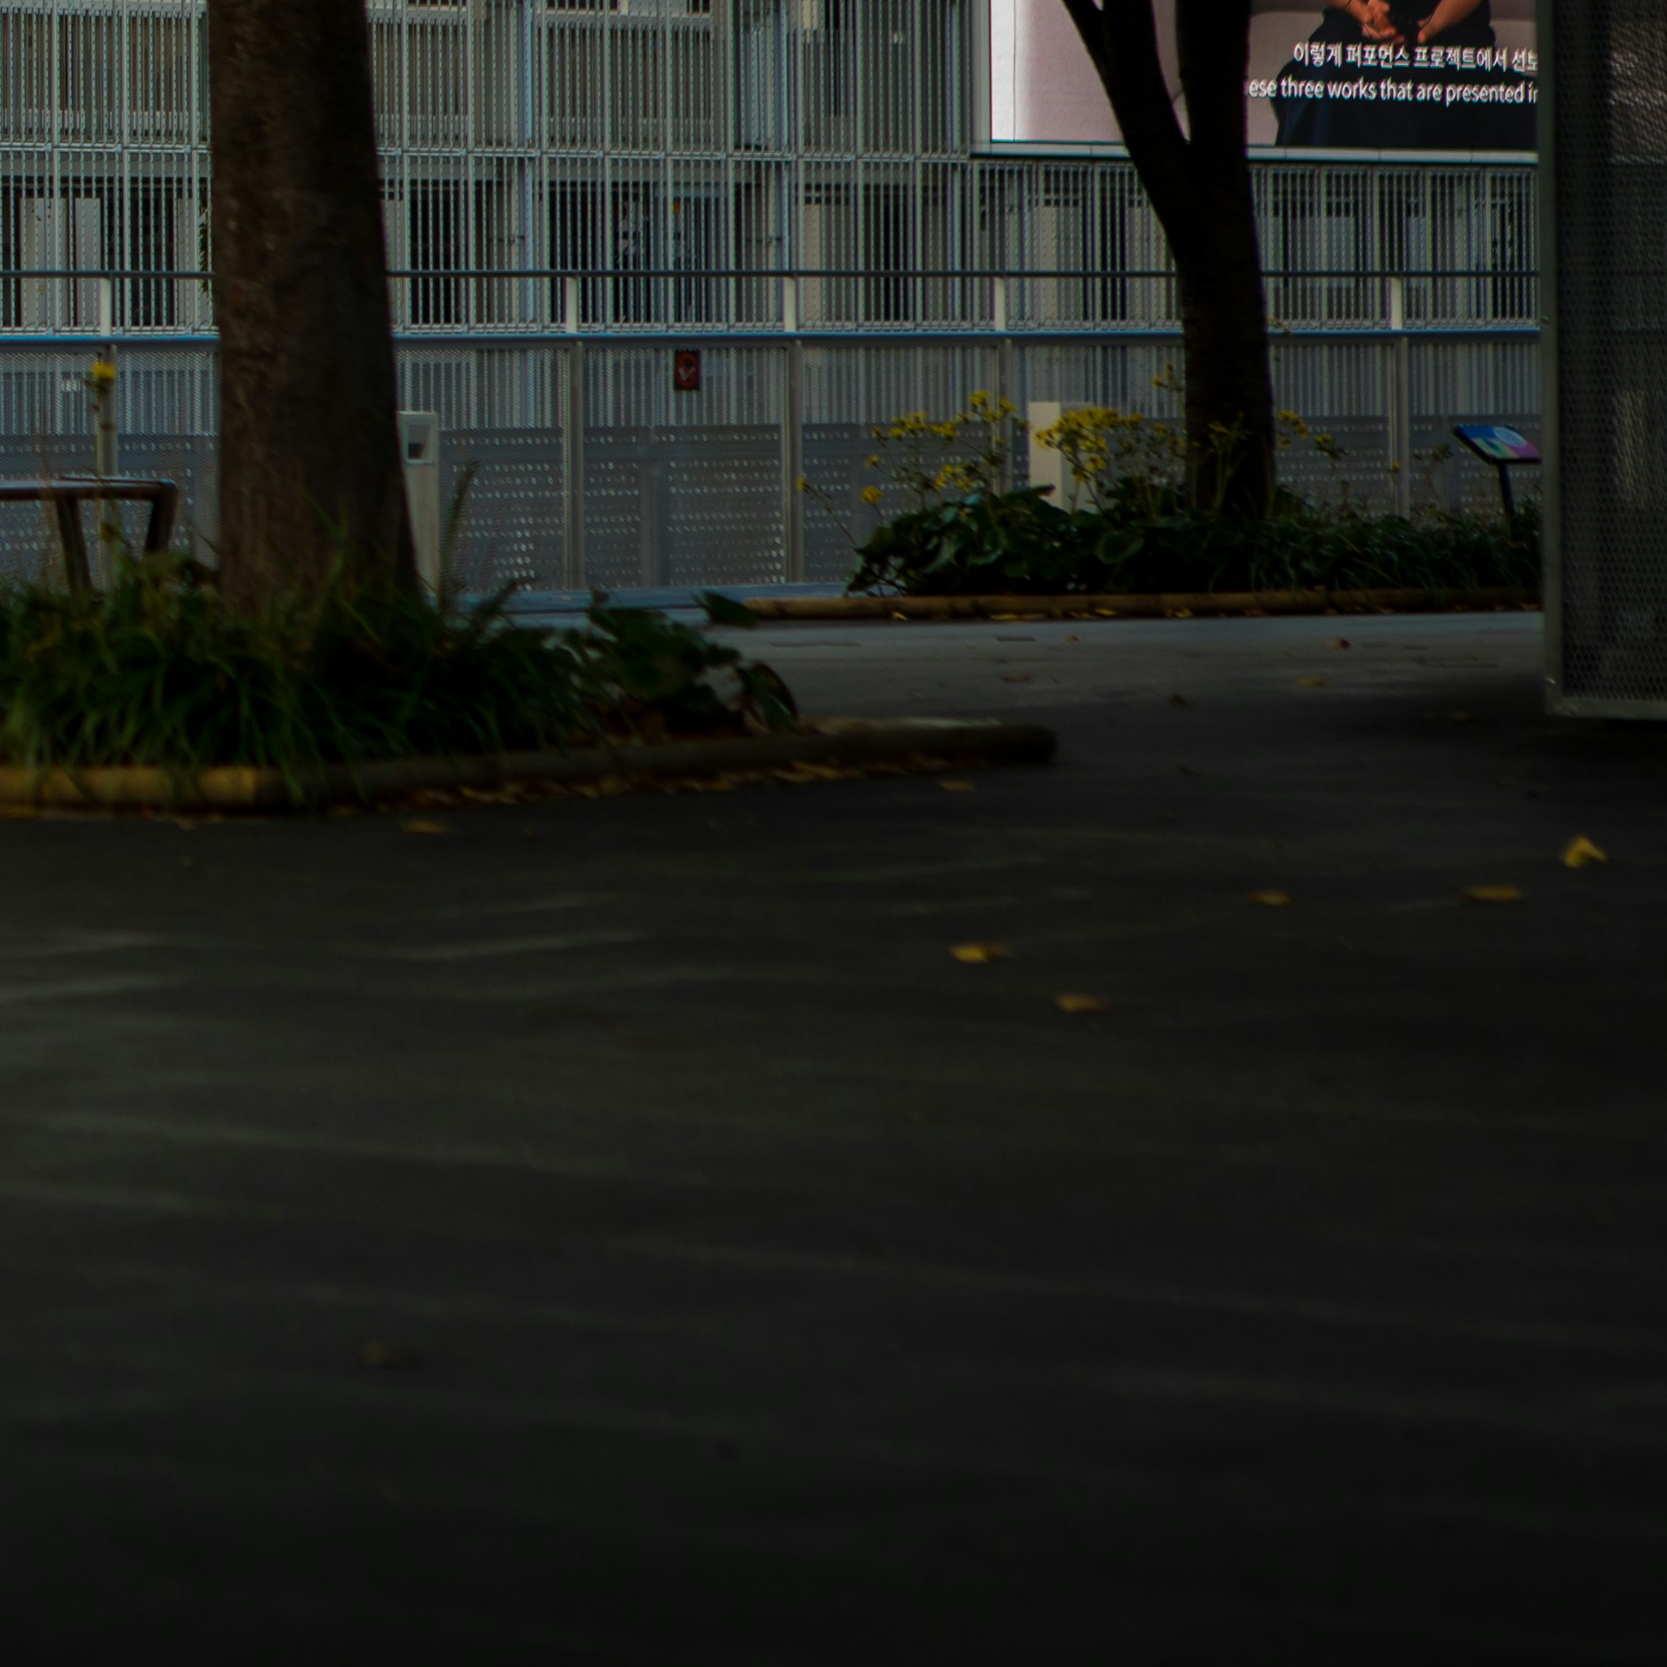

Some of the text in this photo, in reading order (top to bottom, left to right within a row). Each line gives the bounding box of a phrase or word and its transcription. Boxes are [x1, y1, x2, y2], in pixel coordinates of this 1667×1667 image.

[1293, 42, 1343, 68] 이렇게
[1345, 44, 1411, 69] 퍼포먼스
[1413, 45, 1509, 73] 프로젝트에서
[1247, 78, 1278, 99] ese
[1280, 75, 1325, 100] three
[1327, 76, 1378, 101] works
[1380, 77, 1412, 101] that
[1416, 83, 1443, 102] are
[1445, 80, 1525, 108] presented
